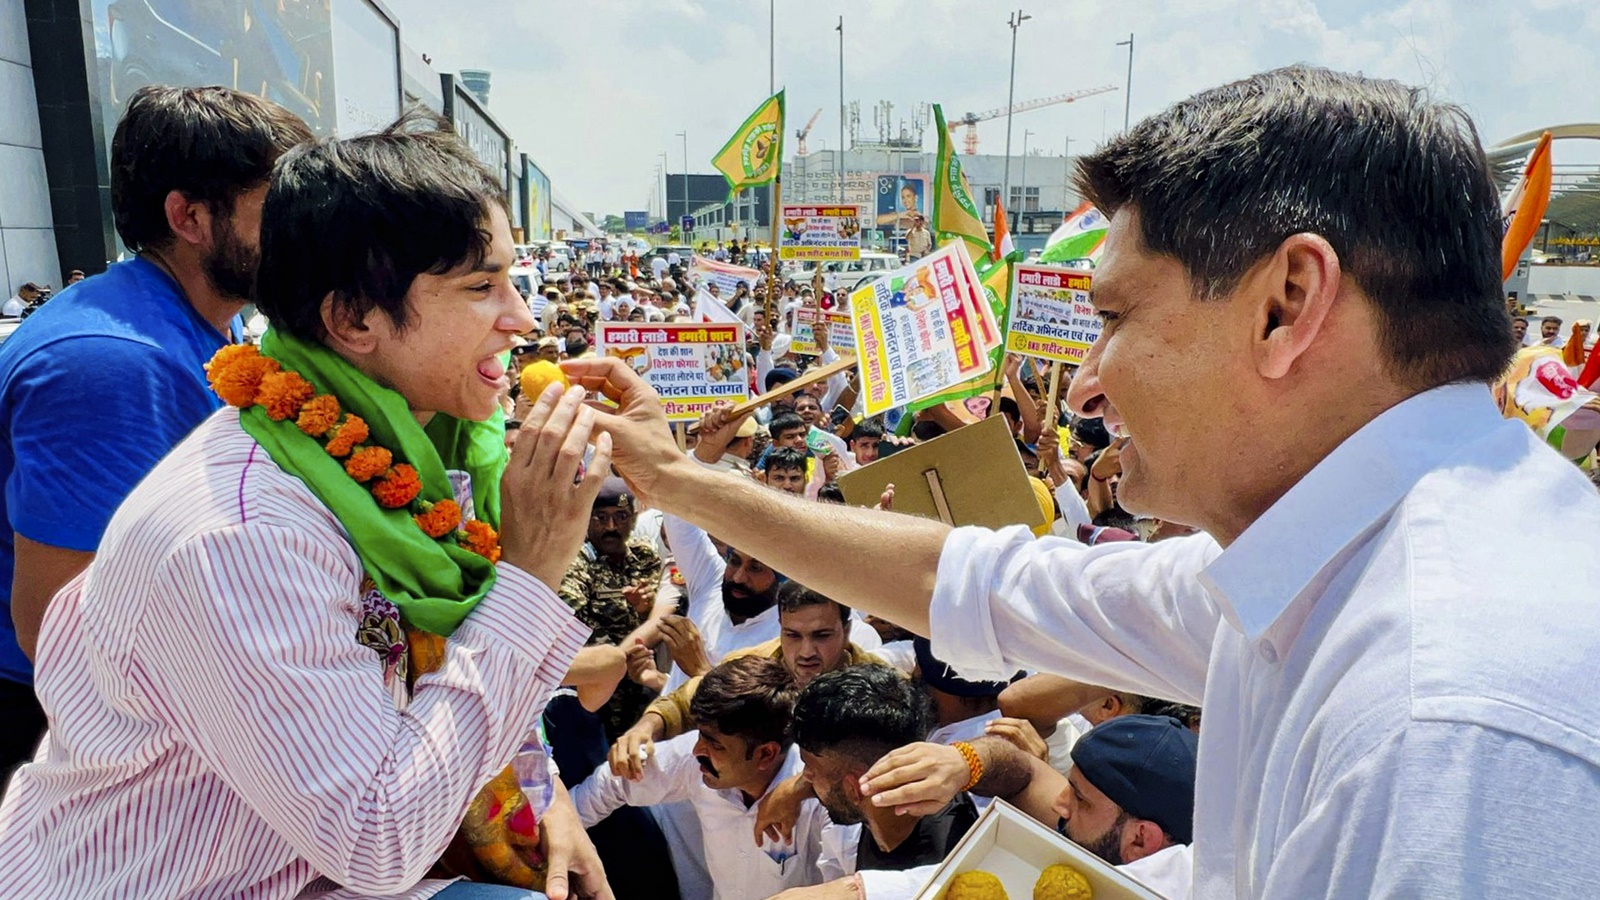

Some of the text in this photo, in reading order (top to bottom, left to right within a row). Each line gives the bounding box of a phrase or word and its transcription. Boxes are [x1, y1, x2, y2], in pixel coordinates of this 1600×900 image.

[1021, 272, 1041, 284] हमारी
[1068, 277, 1091, 289] हमारी
[935, 259, 955, 288] हमारी
[951, 317, 971, 347] हमारी
[608, 329, 638, 342] हमारी
[641, 329, 667, 342] लाडो
[678, 329, 708, 342] हमारी
[710, 330, 734, 342] शान
[1012, 321, 1034, 332] हार्दिक
[1036, 325, 1069, 338] अभिनंदन
[1072, 330, 1083, 340] एवं
[864, 331, 881, 354] शहीद
[875, 281, 906, 401] हार्दिक अभिनंदन एवं स्वागत
[658, 346, 668, 356] देश
[670, 346, 679, 356] की
[1041, 342, 1063, 355] शहीद
[1065, 348, 1084, 358] भगत
[653, 358, 699, 369] विनेश फोगाट
[868, 352, 882, 379] भगत
[650, 373, 659, 381] का
[660, 372, 676, 381] भारत
[696, 372, 704, 380] पर
[692, 382, 707, 395] एवं
[710, 383, 743, 394] स्वागत
[871, 378, 887, 403] सिंह
